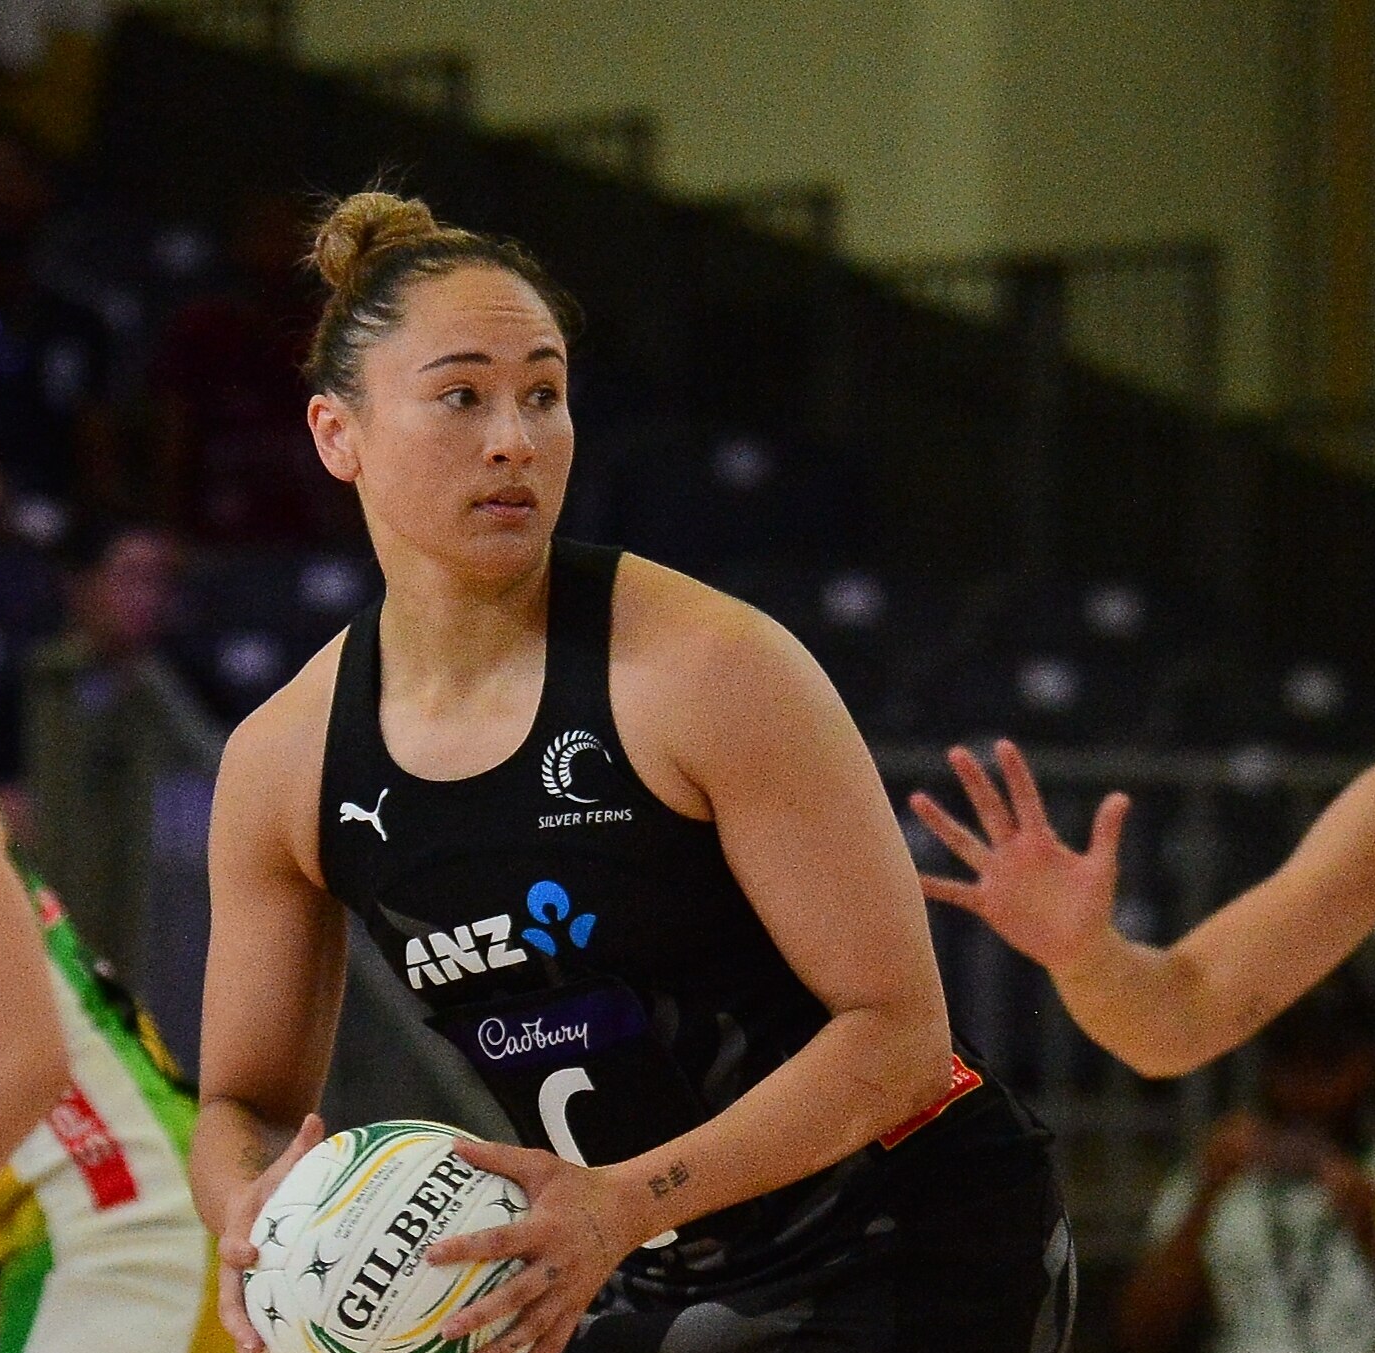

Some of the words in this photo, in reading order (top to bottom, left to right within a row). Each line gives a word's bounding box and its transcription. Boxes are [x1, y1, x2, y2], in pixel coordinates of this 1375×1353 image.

[538, 811, 582, 829] SILVER
[586, 808, 632, 824] FERNS
[406, 913, 527, 989] ANZ
[478, 1017, 588, 1060] Cadbury
